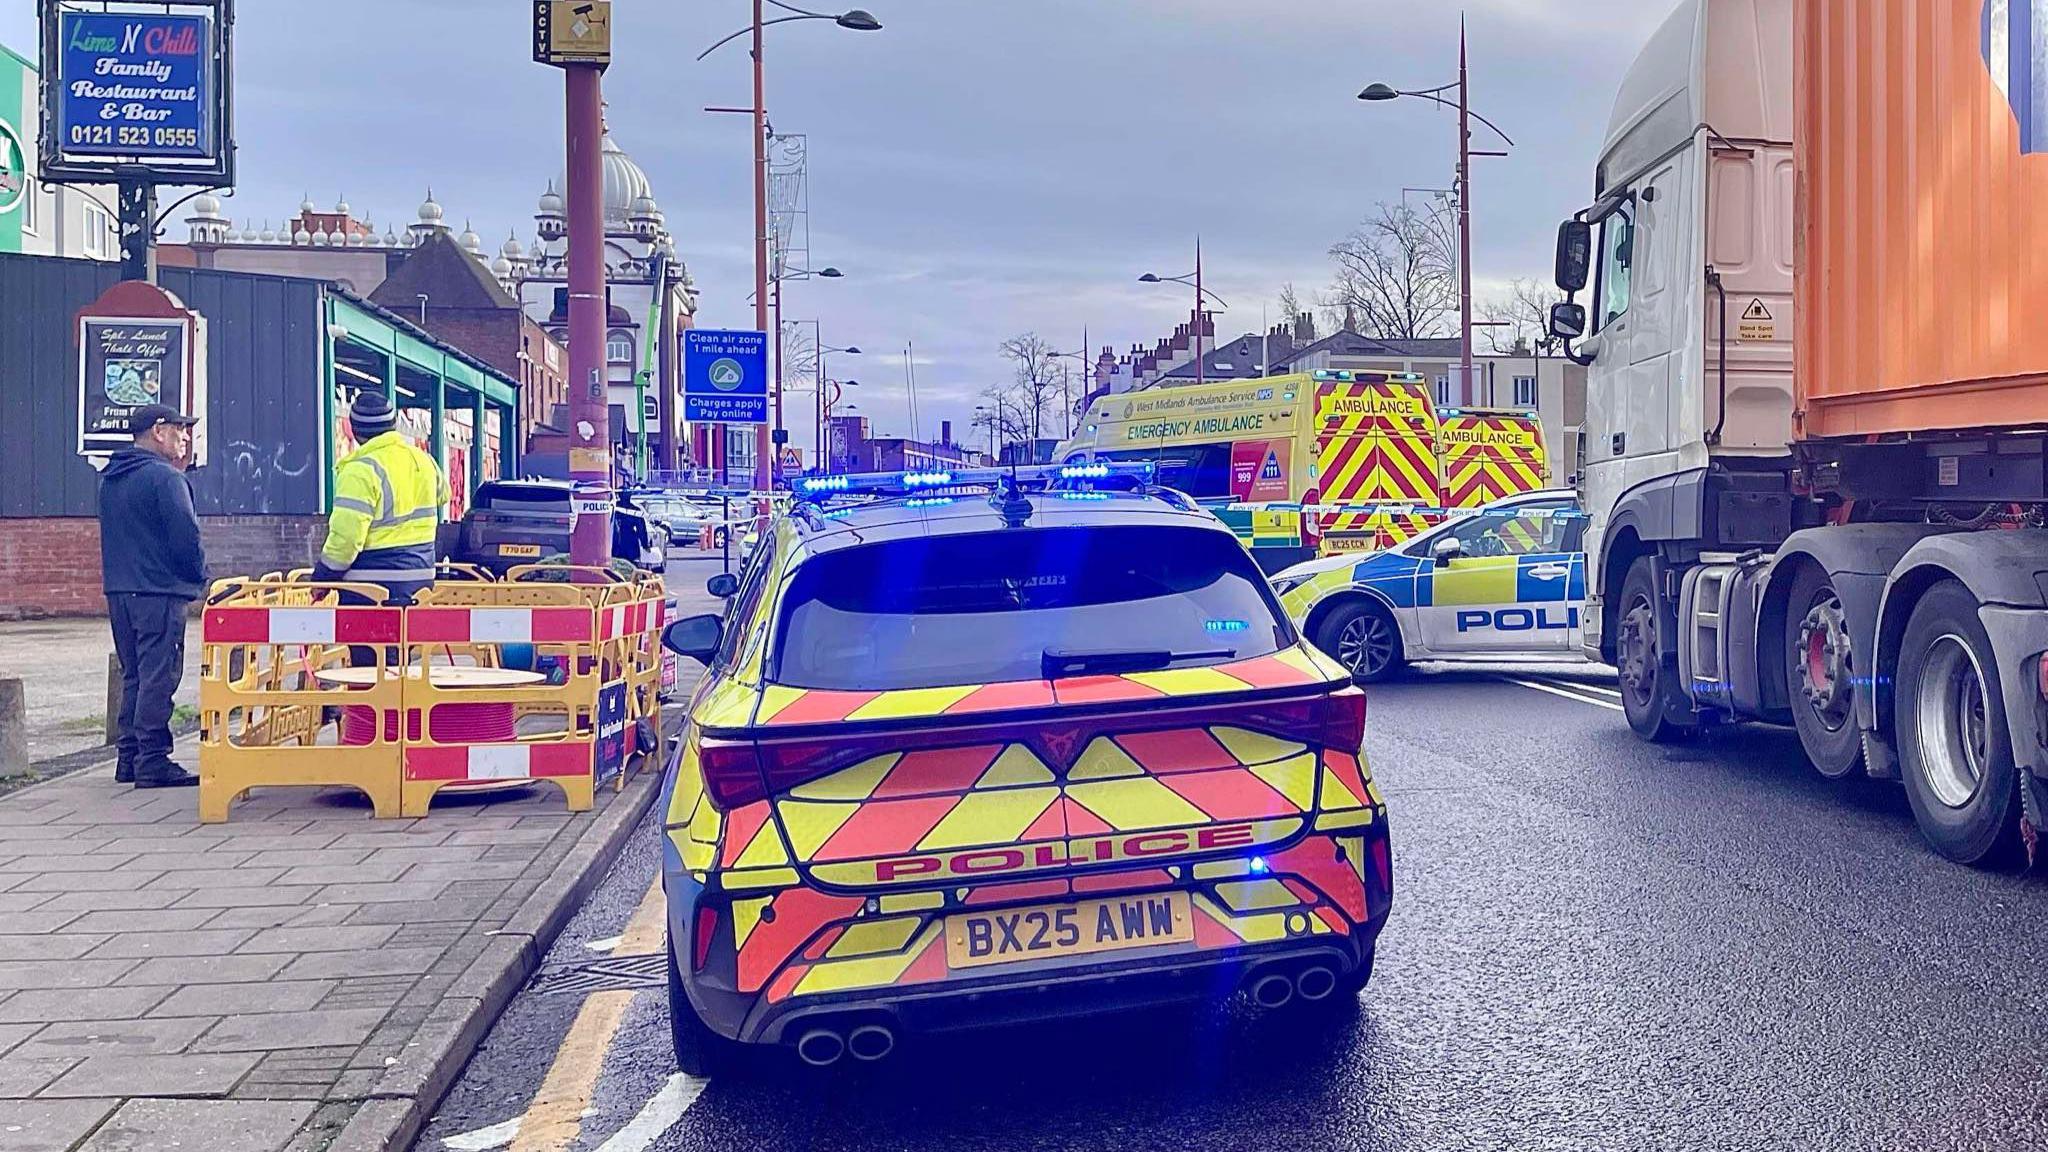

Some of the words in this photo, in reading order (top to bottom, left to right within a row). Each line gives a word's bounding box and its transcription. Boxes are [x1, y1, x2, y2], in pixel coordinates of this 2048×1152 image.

[538, 4, 547, 53] CCTV
[69, 18, 117, 53] Lime
[120, 24, 143, 54] N
[95, 58, 172, 83] Family
[70, 80, 196, 101] Restaurant
[100, 103, 120, 120] &
[121, 103, 172, 121] Bar
[71, 125, 112, 144] 0121
[118, 126, 150, 145] 523
[154, 128, 197, 146] 0555
[130, 330, 168, 340] Lunch
[689, 333, 719, 343] Clean
[722, 334, 735, 344] air
[738, 336, 762, 345] zone
[136, 343, 166, 357] Offer
[694, 344, 699, 353] 1
[702, 344, 724, 353] mile
[727, 345, 757, 354] ahead
[689, 397, 732, 409] Charges
[735, 399, 763, 410] apply
[1136, 402, 1153, 412] West
[1155, 398, 1186, 410] Midlands
[1187, 394, 1228, 407] Ambulance
[1229, 392, 1256, 402] Service
[1257, 389, 1273, 400] NHS
[1334, 400, 1413, 414] AMBULANCE
[103, 406, 128, 416] From
[700, 408, 719, 418] Pay
[721, 409, 753, 418] online
[100, 419, 120, 429] Soft
[1127, 421, 1191, 440] EMERGENCY
[1193, 414, 1264, 434] AMBULANCE
[1442, 430, 1523, 444] AMBULANCE
[1265, 466, 1278, 477] 111
[583, 502, 609, 511] POLIC
[1457, 607, 1579, 632] POLI
[875, 825, 1254, 881] POLICE
[966, 907, 1080, 958] BX25
[1094, 897, 1173, 943] AWW
